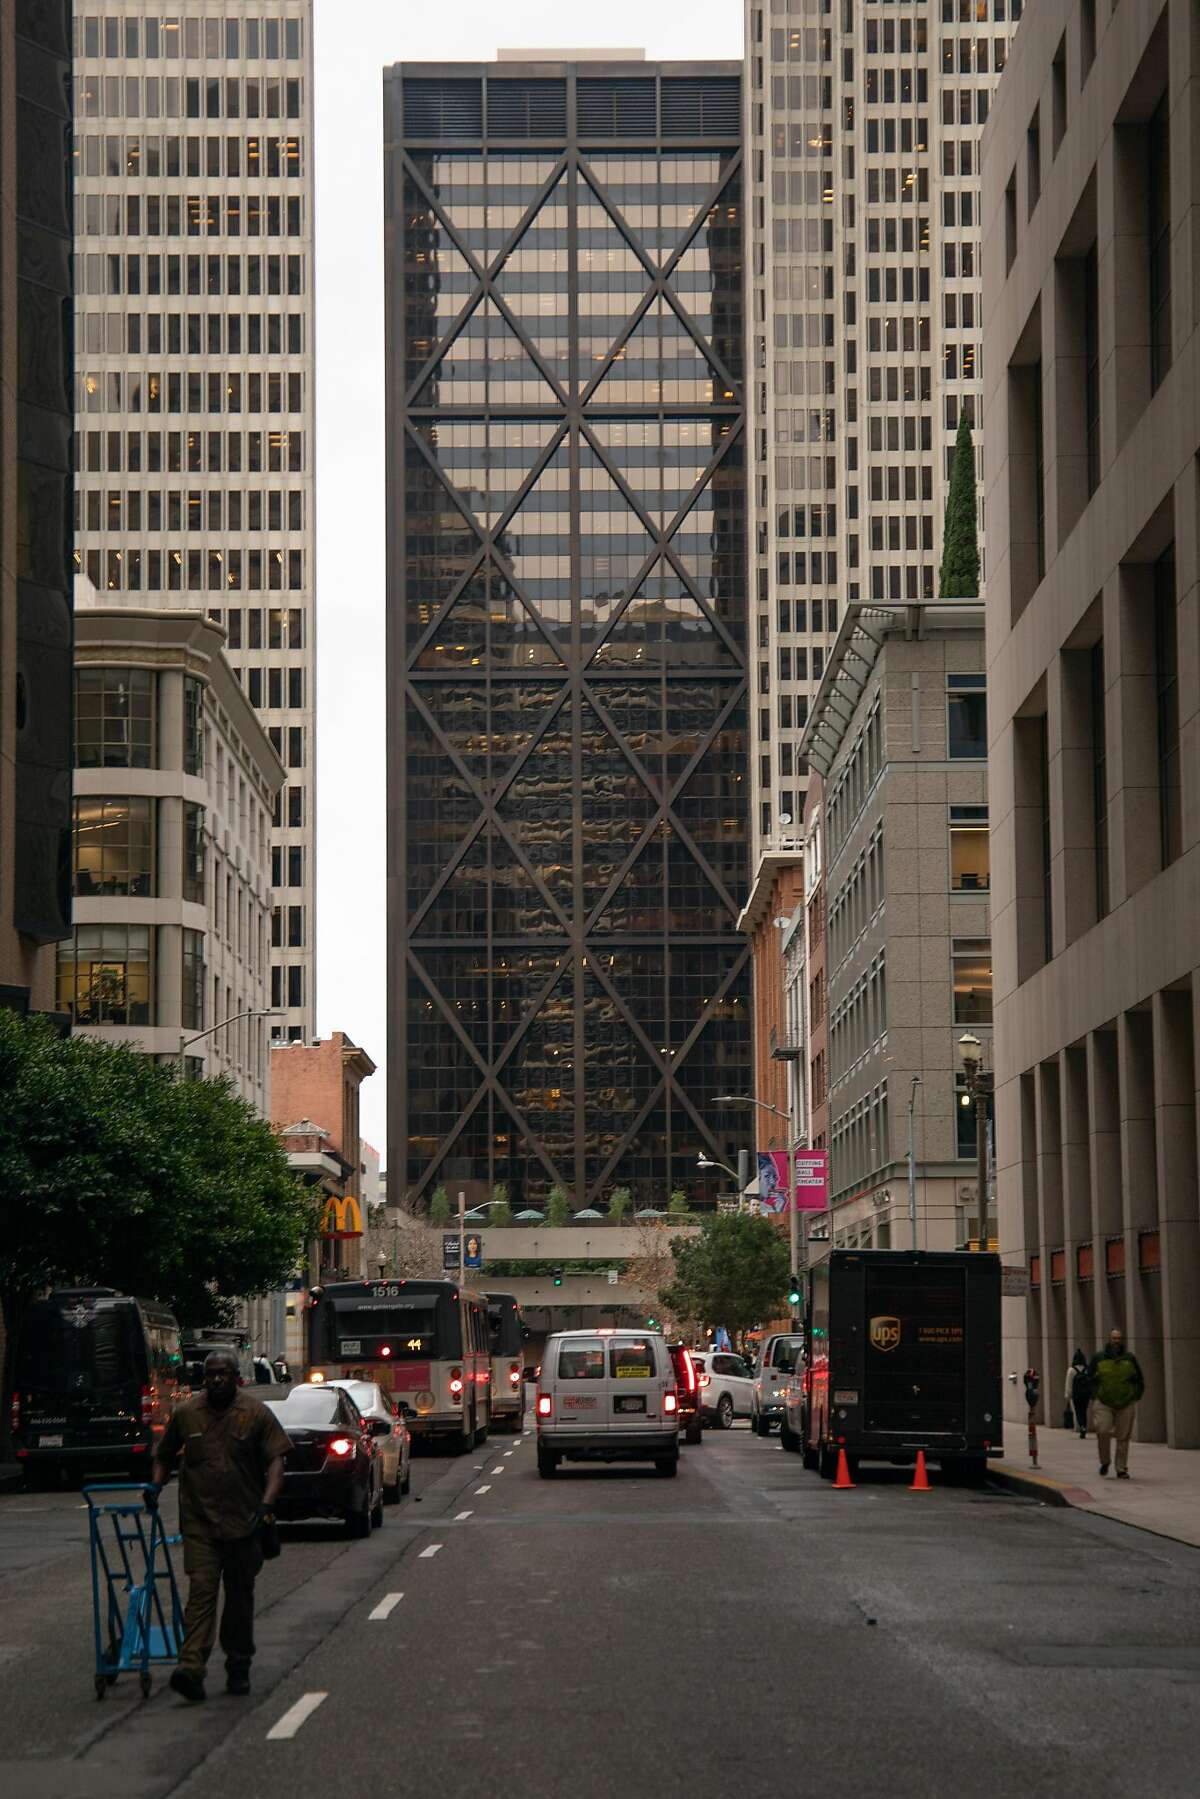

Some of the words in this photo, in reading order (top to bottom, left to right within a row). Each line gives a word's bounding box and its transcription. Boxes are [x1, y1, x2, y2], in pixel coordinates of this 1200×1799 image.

[372, 1286, 399, 1297] 1516
[873, 1327, 898, 1346] ups
[407, 1339, 421, 1351] 44
